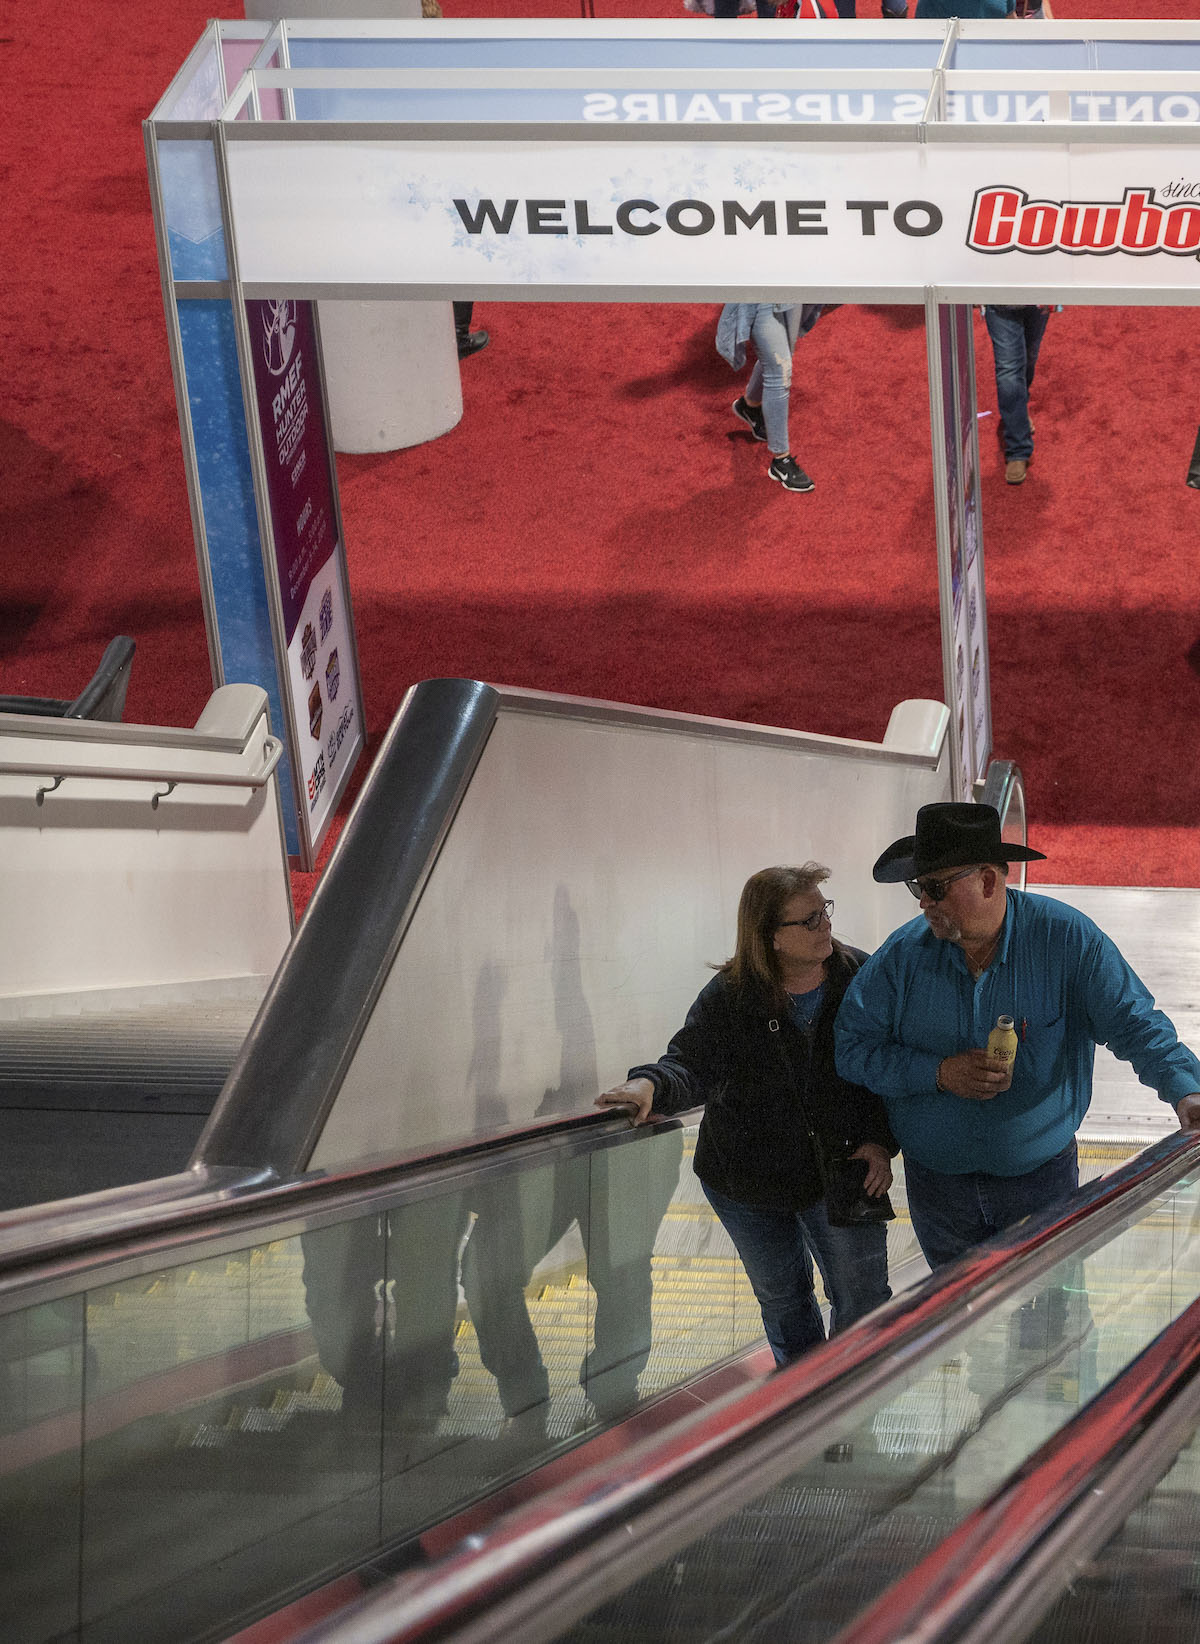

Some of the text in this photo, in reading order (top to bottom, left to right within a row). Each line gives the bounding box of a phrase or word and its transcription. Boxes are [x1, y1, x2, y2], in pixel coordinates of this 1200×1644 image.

[452, 199, 943, 237] WELCOME TO
[272, 350, 302, 424] RMEF
[276, 379, 306, 445] HUNTER
[279, 402, 308, 465] OUTDOOR
